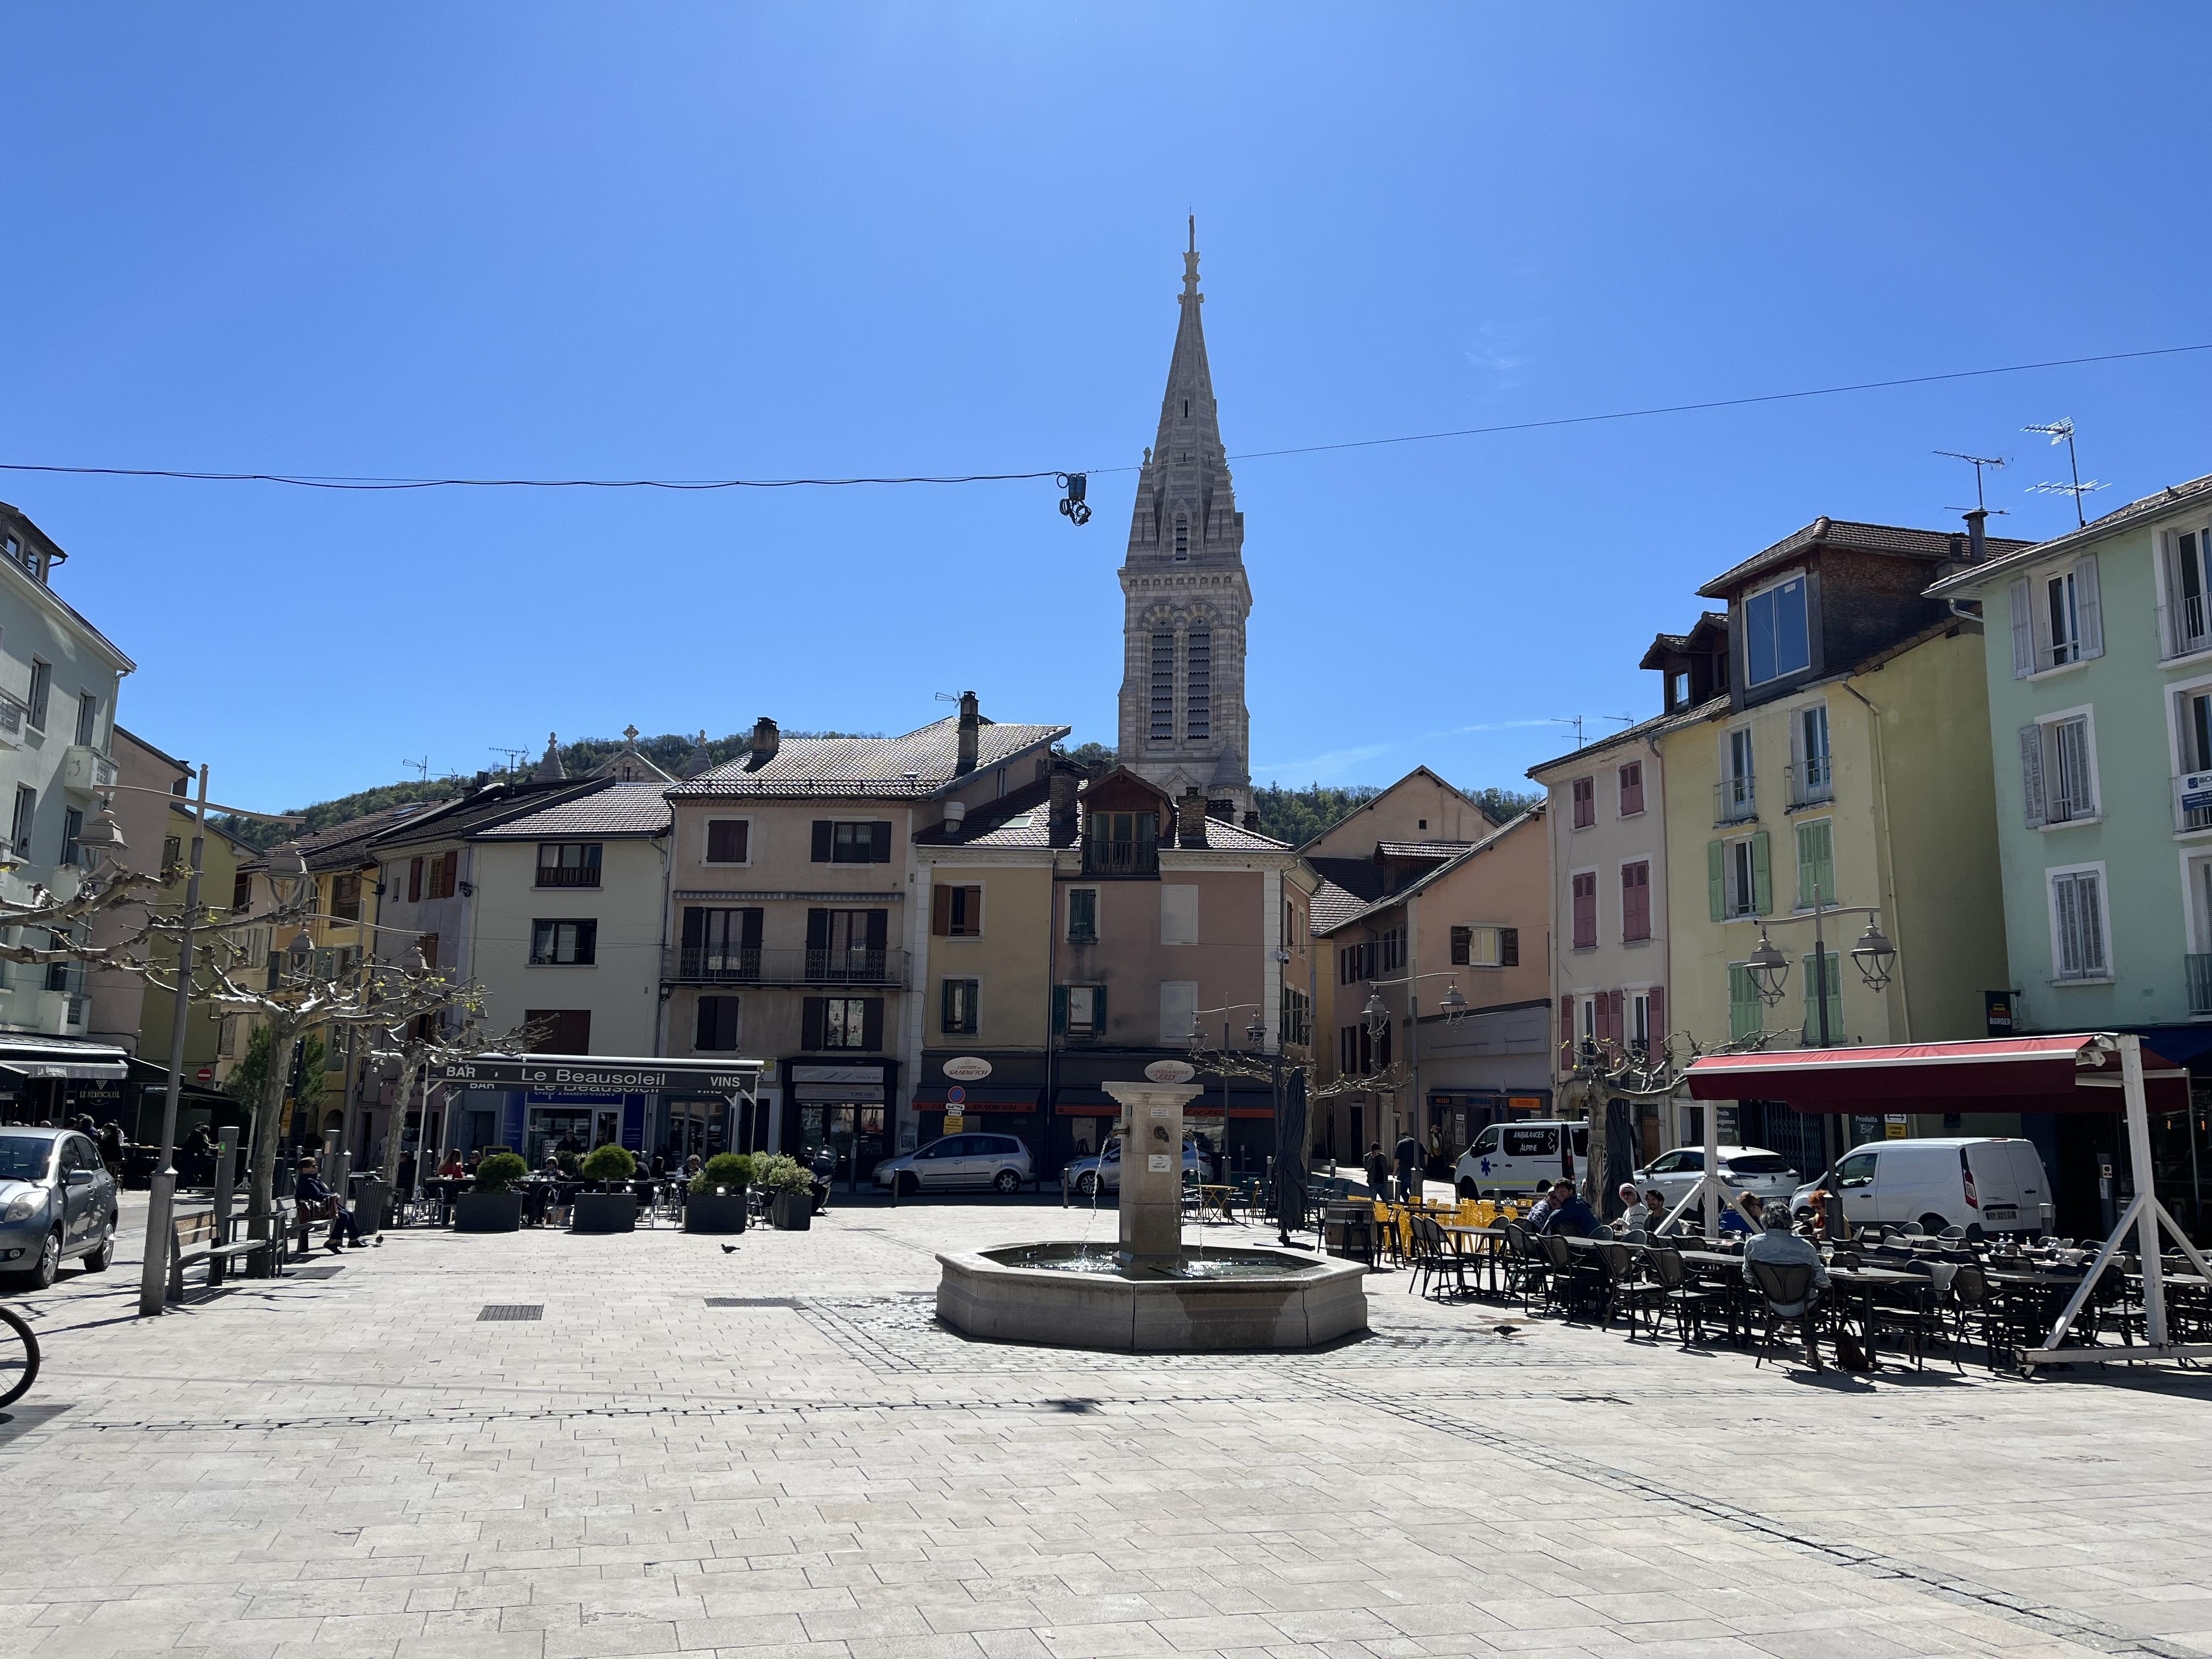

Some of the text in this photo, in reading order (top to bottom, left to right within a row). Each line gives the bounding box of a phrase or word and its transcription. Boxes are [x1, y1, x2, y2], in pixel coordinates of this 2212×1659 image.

[446, 1066, 476, 1078] BAR
[521, 1068, 665, 1086] Le Beausoleil
[710, 1076, 741, 1087] VINS
[1513, 1131, 1545, 1139] AMBULANCES
[1519, 1142, 1538, 1153] ALPINE
